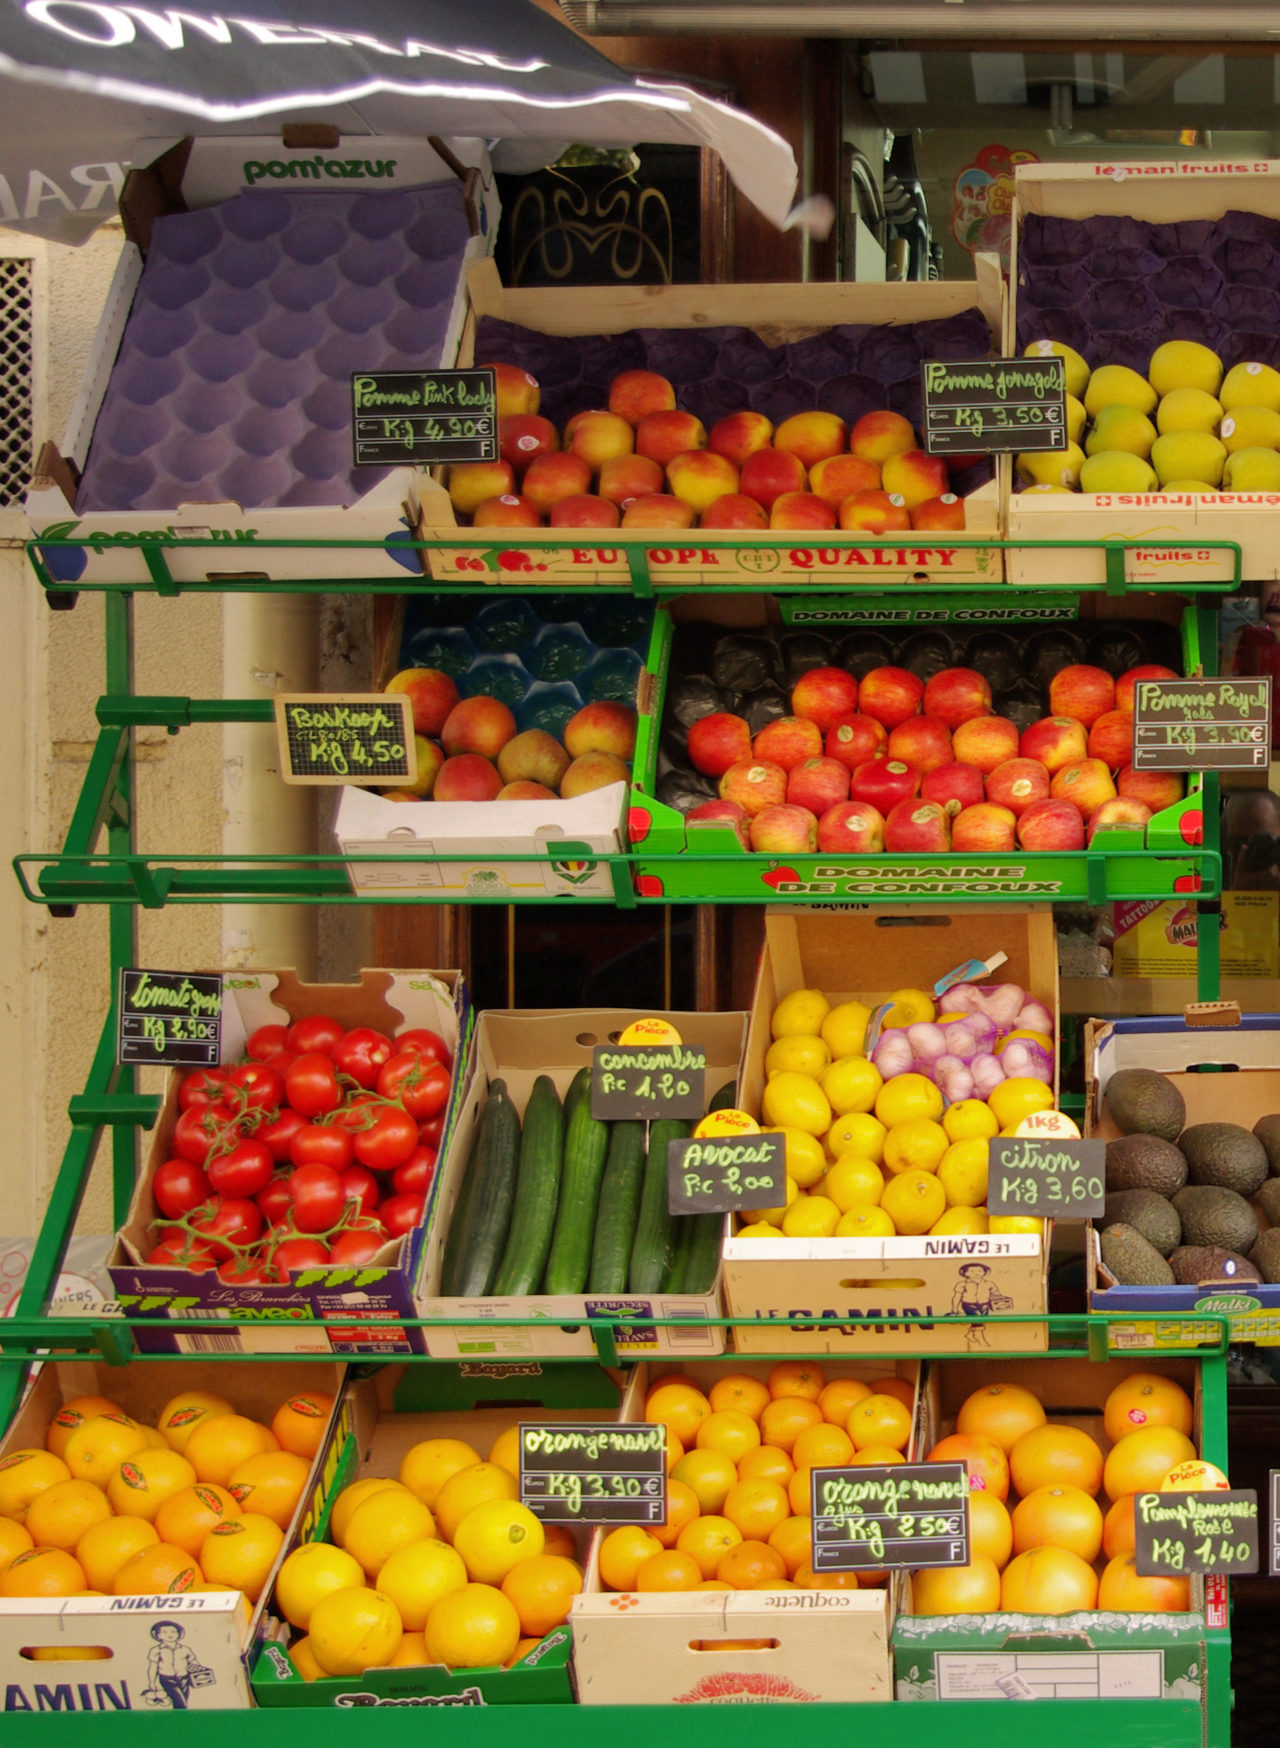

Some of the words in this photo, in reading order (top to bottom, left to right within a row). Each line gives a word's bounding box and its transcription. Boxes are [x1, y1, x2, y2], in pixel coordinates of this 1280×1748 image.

[243, 155, 398, 185] pom'azur
[1181, 163, 1250, 174] fruits
[927, 363, 994, 393] Pomme
[354, 378, 421, 408] Pomme
[424, 380, 454, 406] Pink
[1118, 494, 1194, 507] fruits
[571, 547, 720, 565] EUOPE
[788, 548, 958, 567] QUALITY
[1135, 551, 1193, 561] fruits
[792, 610, 910, 622] DOMAINE
[913, 610, 949, 622] DE
[952, 607, 1076, 621] CONFOUX
[1140, 683, 1216, 712] Pomme
[352, 739, 405, 767] 4,50
[814, 866, 1026, 879] DOMAINE
[776, 881, 837, 894] DE
[847, 881, 1063, 894] CONFOUX
[600, 1045, 706, 1070] concombre
[1026, 1115, 1061, 1131] 1kg
[1001, 1140, 1080, 1173] citron
[1045, 1176, 1104, 1204] 3,60
[925, 1238, 990, 1255] GAMIN
[996, 1243, 1010, 1254] LE
[1194, 1536, 1250, 1565] 1,40
[110, 1596, 184, 1611] GAMIN
[190, 1598, 206, 1609] LE
[765, 1592, 850, 1608] coquette
